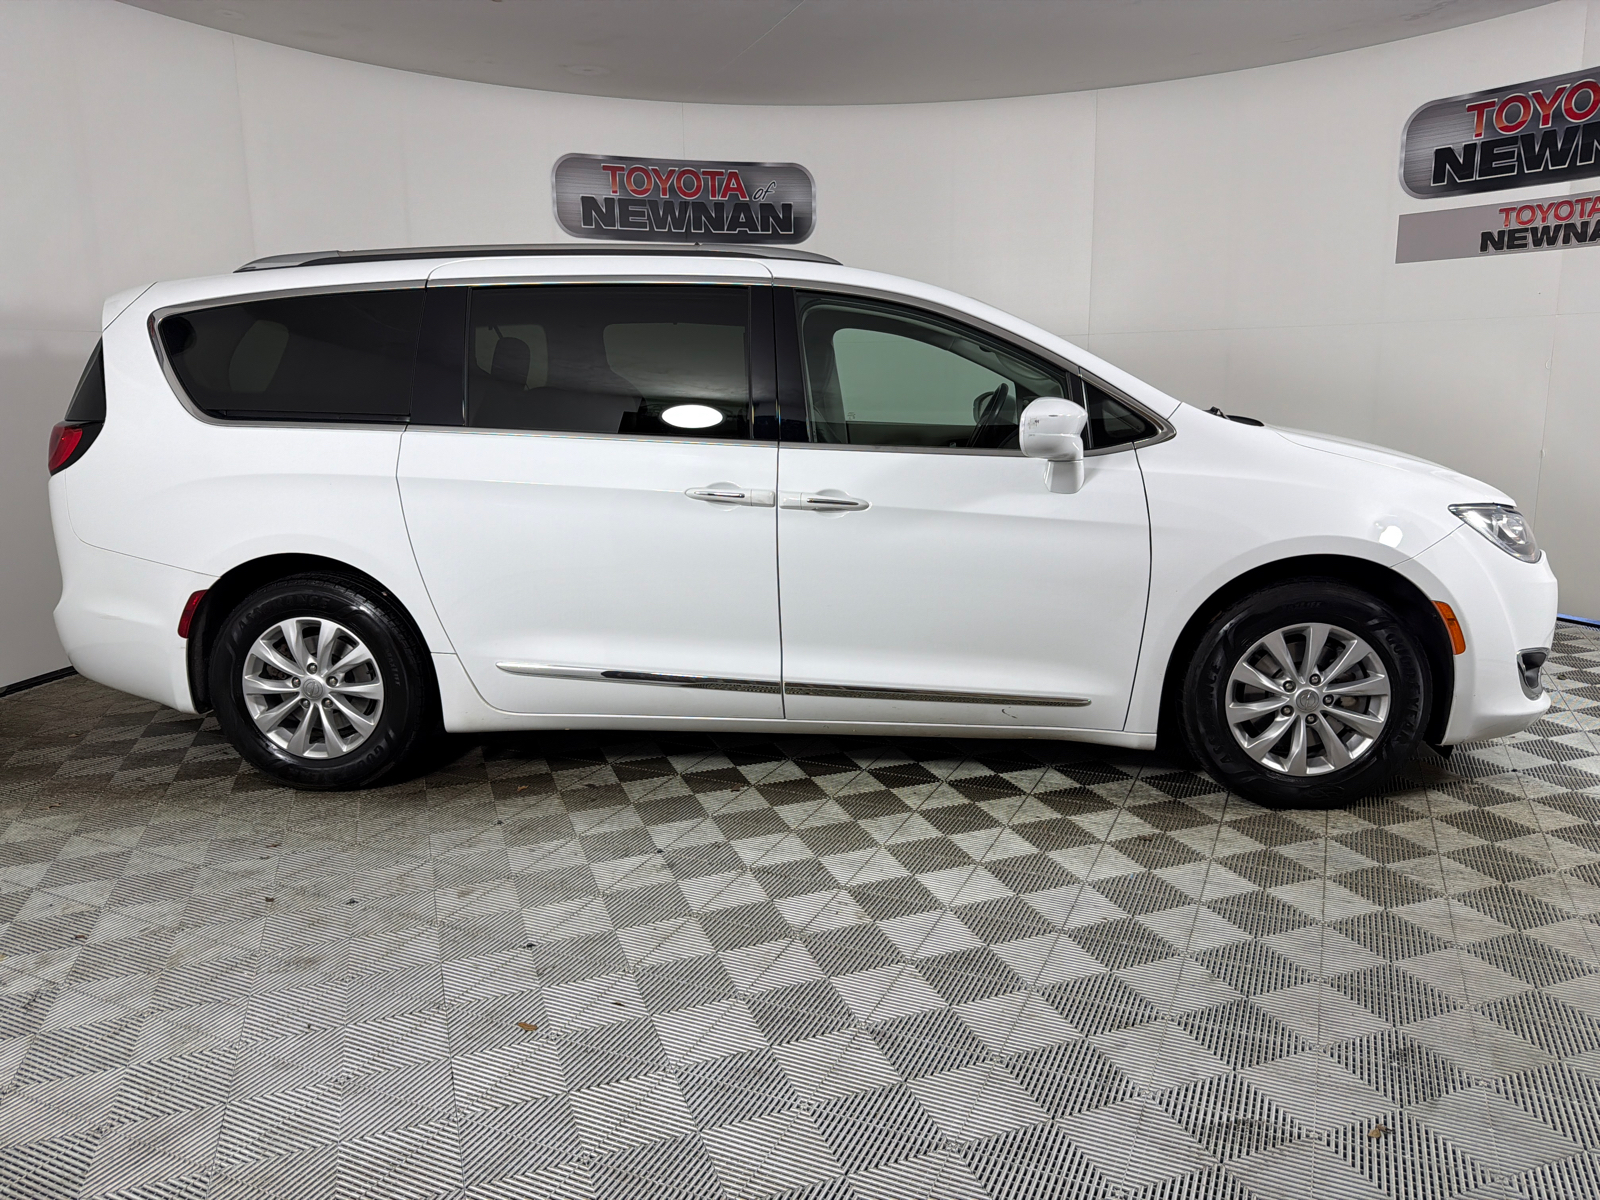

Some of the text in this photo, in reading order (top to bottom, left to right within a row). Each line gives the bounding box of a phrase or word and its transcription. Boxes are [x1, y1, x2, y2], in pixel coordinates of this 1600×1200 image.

[601, 164, 777, 202] TOYOTA of
[580, 195, 795, 234] NEWNAN
